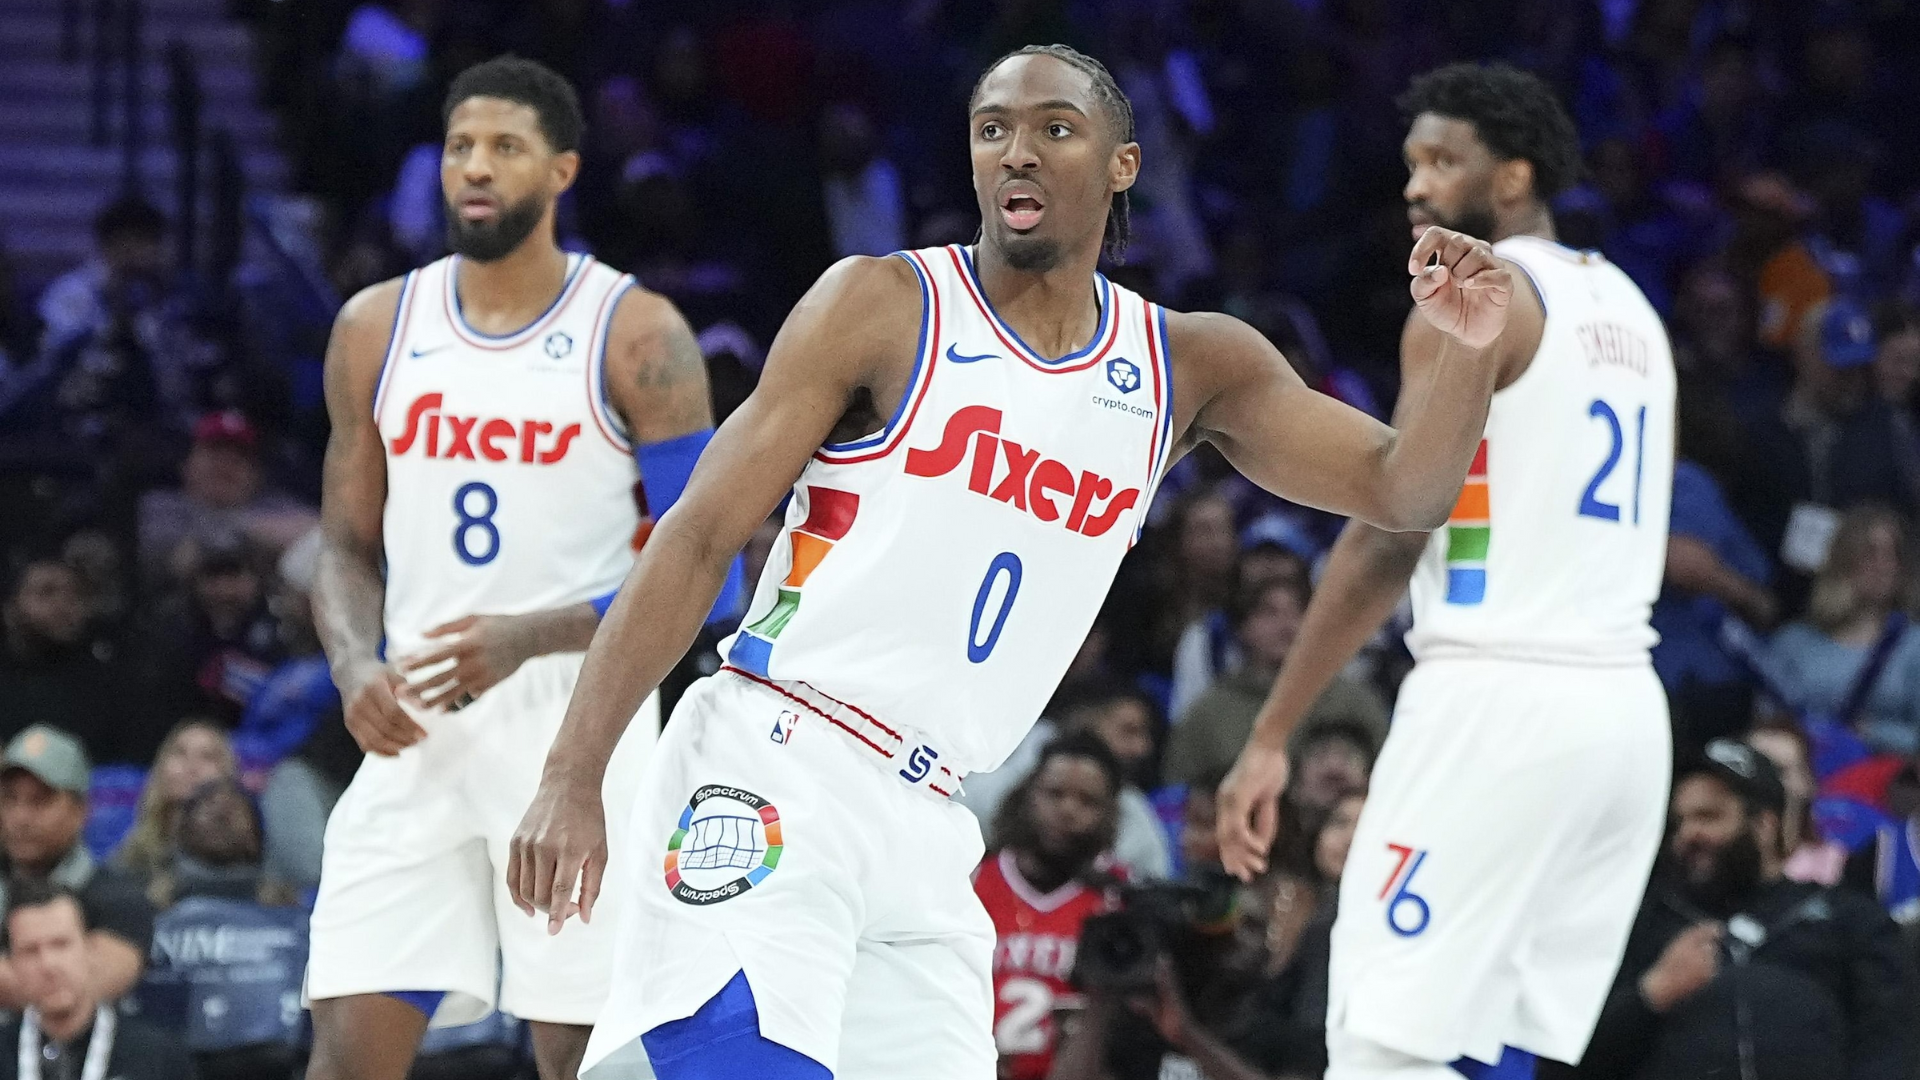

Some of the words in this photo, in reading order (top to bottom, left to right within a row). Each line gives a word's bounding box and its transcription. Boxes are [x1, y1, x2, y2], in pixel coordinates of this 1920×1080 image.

[391, 391, 581, 465] Sixers
[1092, 396, 1153, 419] crypto.com
[904, 405, 1140, 537] Sixers
[1578, 399, 1646, 525] 21
[454, 481, 500, 566] 8
[967, 551, 1023, 664] 0
[695, 787, 759, 806] Spectrum
[680, 883, 740, 902] Spectrum
[1377, 843, 1430, 937] 76
